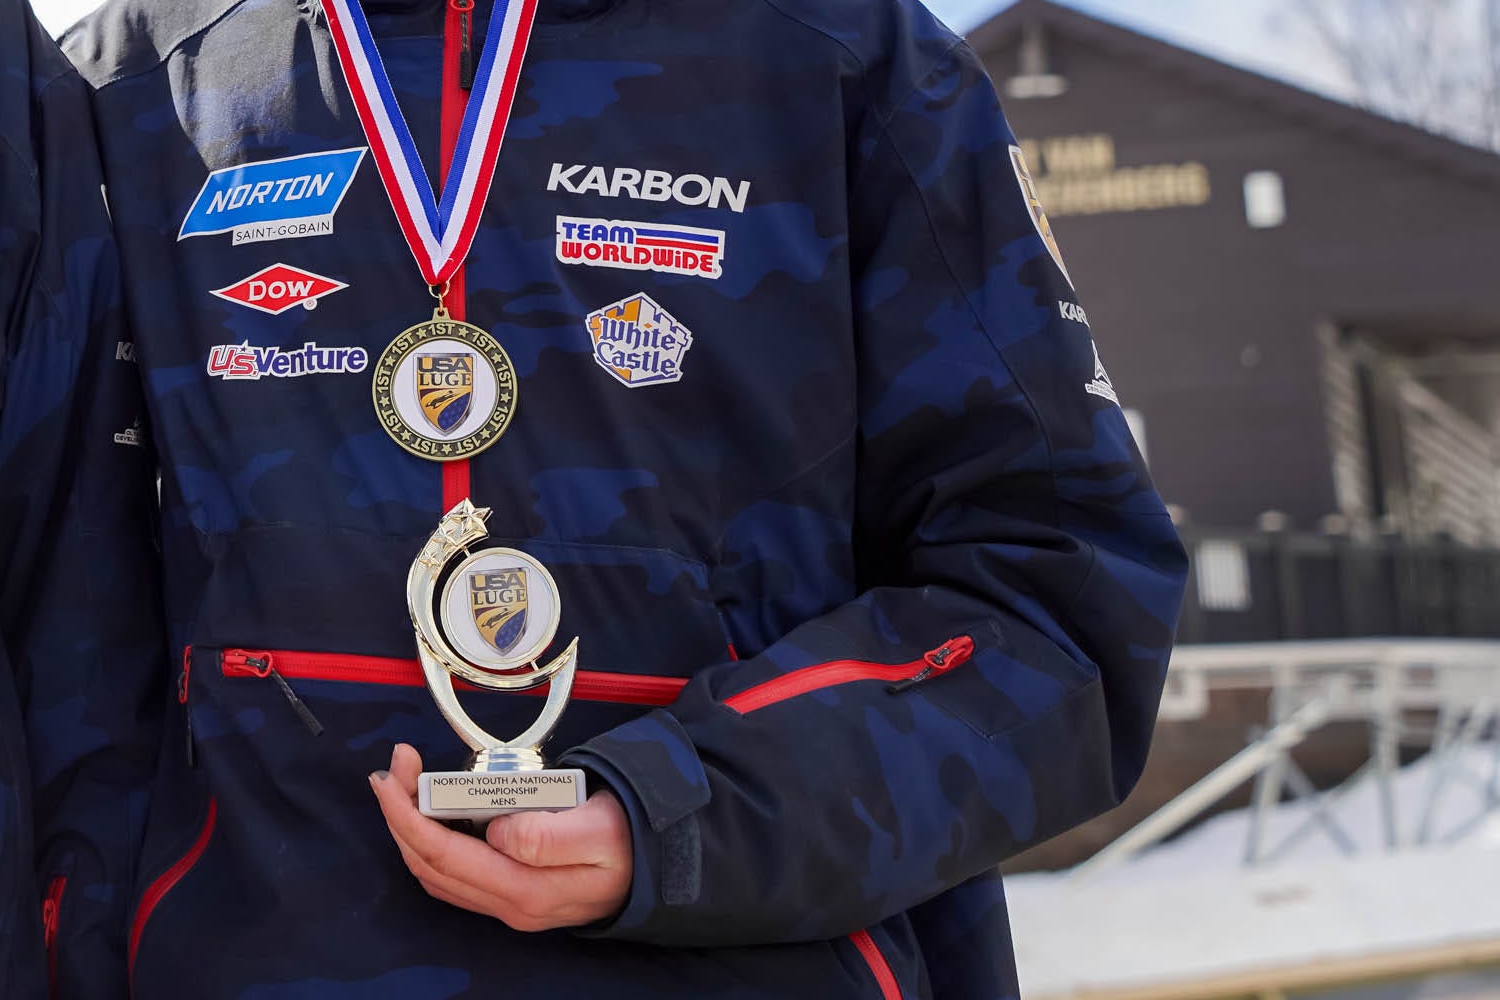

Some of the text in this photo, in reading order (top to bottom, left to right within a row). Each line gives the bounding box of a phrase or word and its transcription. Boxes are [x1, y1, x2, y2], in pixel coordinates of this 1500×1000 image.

[205, 172, 334, 215] NORTON
[547, 162, 751, 213] KARBON
[235, 221, 331, 242] SAINT-GOBAIN
[562, 222, 634, 244] TEAM
[247, 280, 315, 302] DOW
[1058, 300, 1090, 328] KAR
[427, 323, 456, 336] 1ST
[600, 317, 676, 351] White
[391, 332, 414, 355] 1ST
[472, 331, 497, 354] 1ST
[418, 357, 472, 372] USA
[597, 341, 676, 375] Castle
[376, 367, 391, 393] 1ST
[419, 372, 472, 386] LUGE
[497, 363, 513, 391] 1ST
[380, 407, 401, 434] 1ST
[492, 404, 509, 432] 1ST
[410, 438, 438, 455] 1ST
[455, 437, 481, 455] 1ST
[469, 573, 525, 591] USA
[472, 589, 527, 605] LUGE
[433, 775, 572, 786] NORTON YOUTH A NATIONALS
[468, 787, 538, 796] CHAMPIONSHIP
[490, 798, 517, 806] MENS
